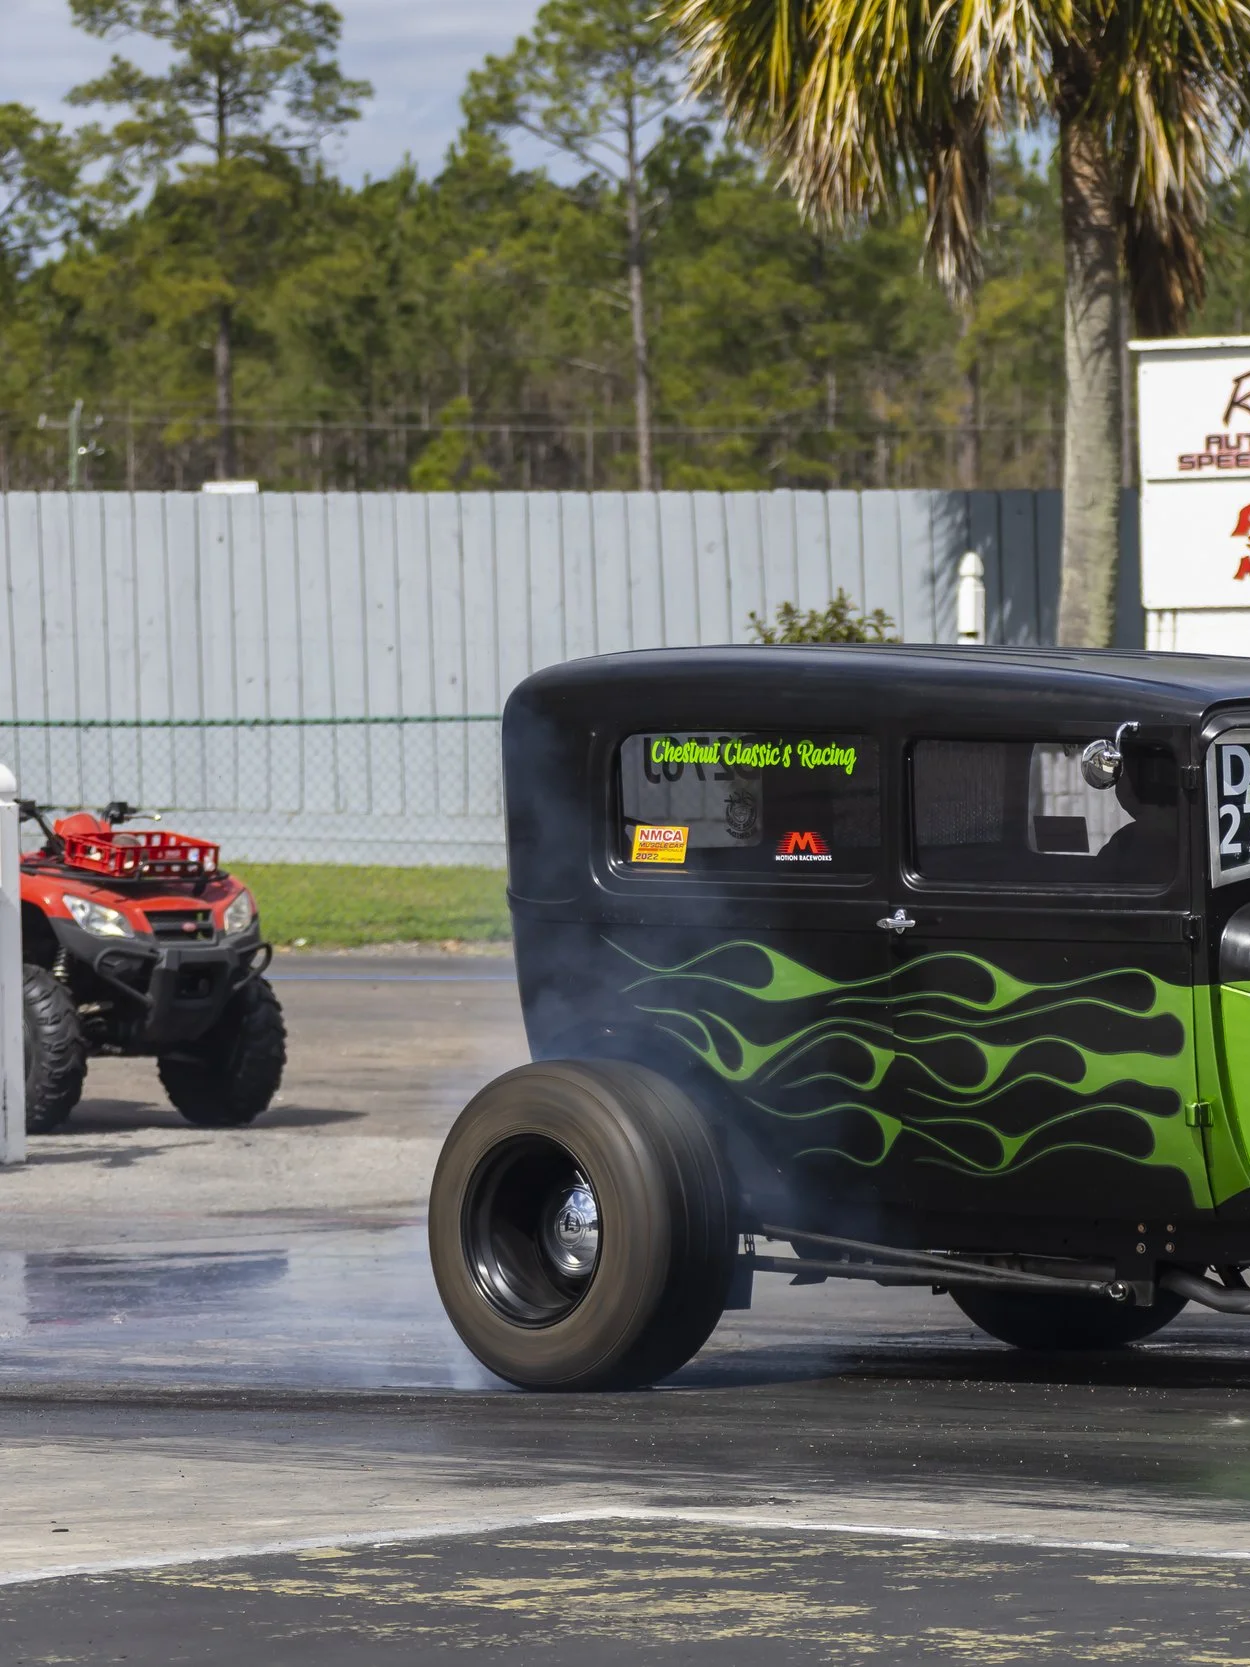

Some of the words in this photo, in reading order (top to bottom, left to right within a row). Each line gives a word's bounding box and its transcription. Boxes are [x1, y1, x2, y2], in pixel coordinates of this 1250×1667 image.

[651, 738, 721, 764] Chestnut
[797, 739, 857, 775] Racing
[639, 828, 684, 842] NMCA
[635, 852, 659, 861] 2022
[799, 854, 833, 862] RACEWORKS
